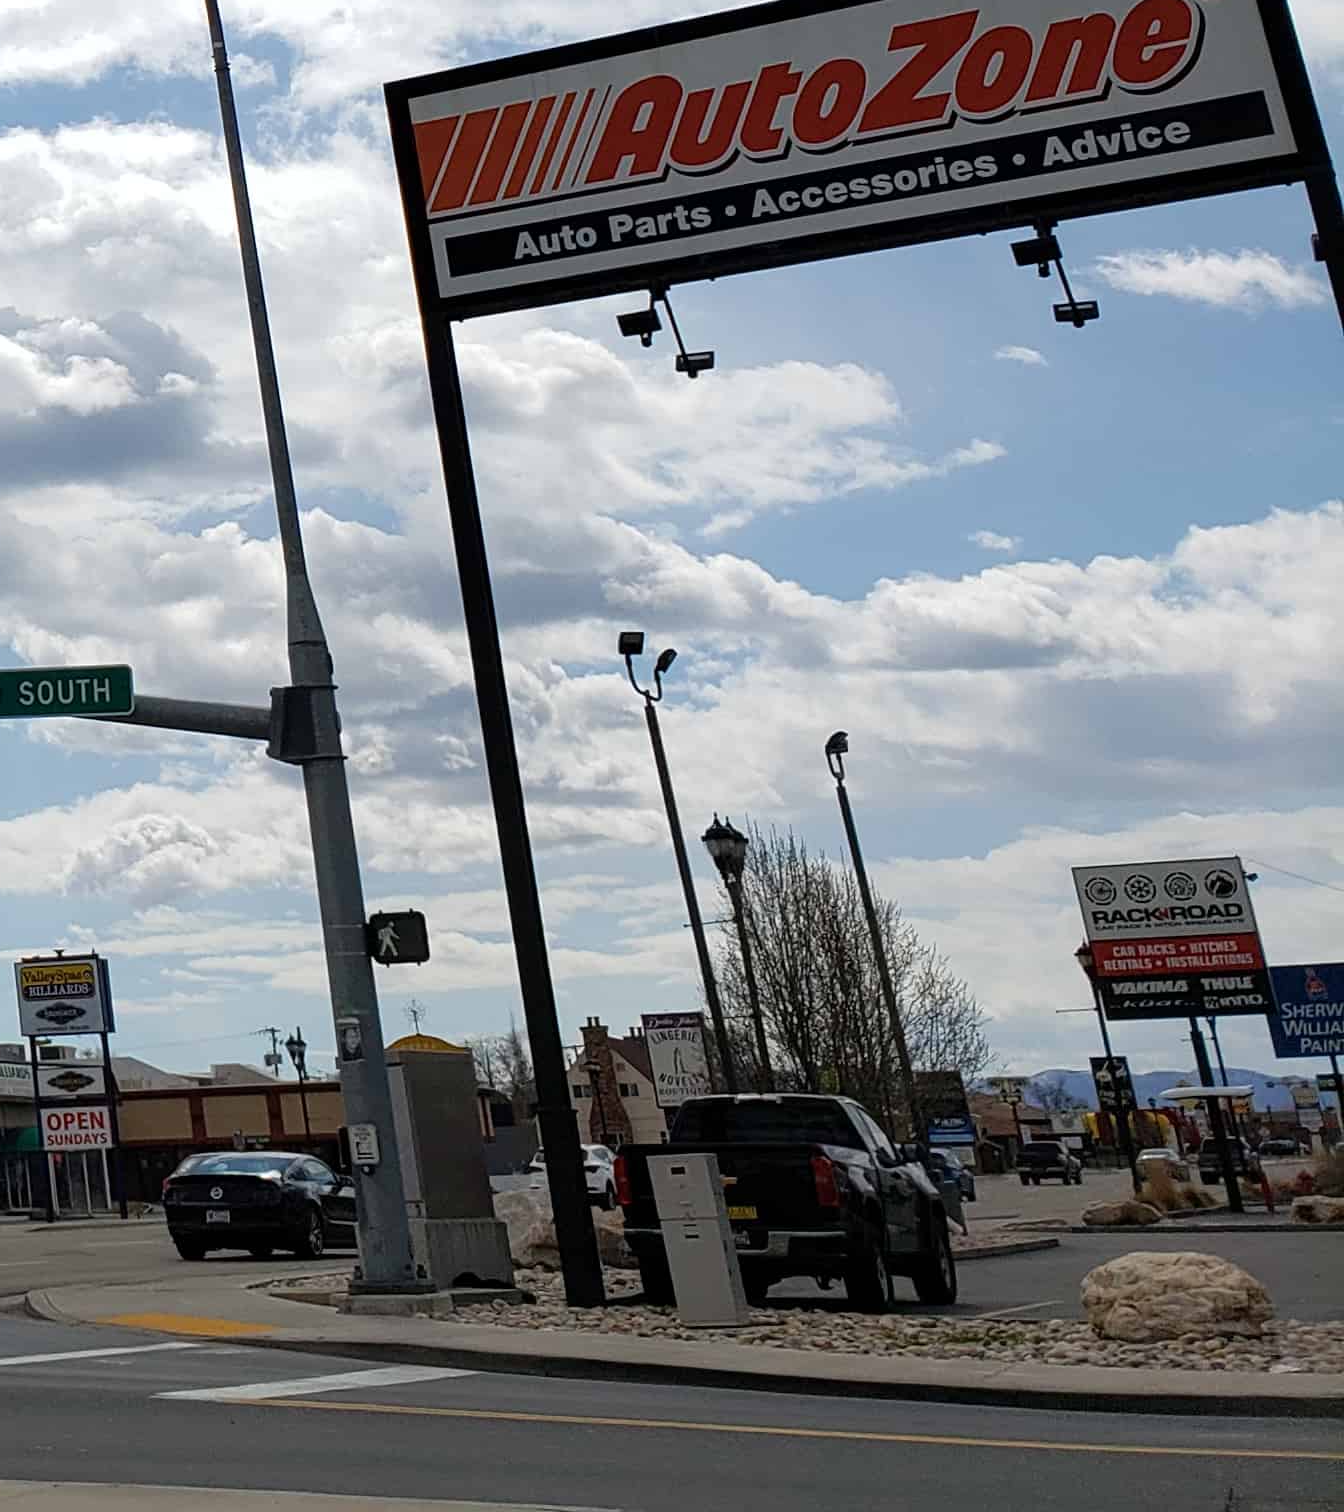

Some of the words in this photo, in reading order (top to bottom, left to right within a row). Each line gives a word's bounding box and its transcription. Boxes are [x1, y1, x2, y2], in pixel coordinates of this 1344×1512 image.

[513, 226, 598, 263] Auto
[609, 201, 712, 241] Parts
[750, 151, 1000, 220] Accessories
[1042, 116, 1192, 168] Advice
[19, 678, 111, 706] SOUTH
[1112, 946, 1136, 957] CAR
[1138, 943, 1176, 956] RACKS
[1189, 941, 1238, 953] HITCHES
[1103, 958, 1152, 971] RENTALS
[1166, 953, 1253, 969] INSTALLATIONS
[29, 984, 89, 997] BILLIARDS
[1111, 979, 1189, 995] YAKIMA
[1200, 976, 1254, 991] THULE
[651, 1030, 699, 1044] LINGERIE
[1281, 1019, 1344, 1037] WILLIA
[47, 1111, 105, 1131] OPEN
[47, 1133, 108, 1146] SUNDAYS
